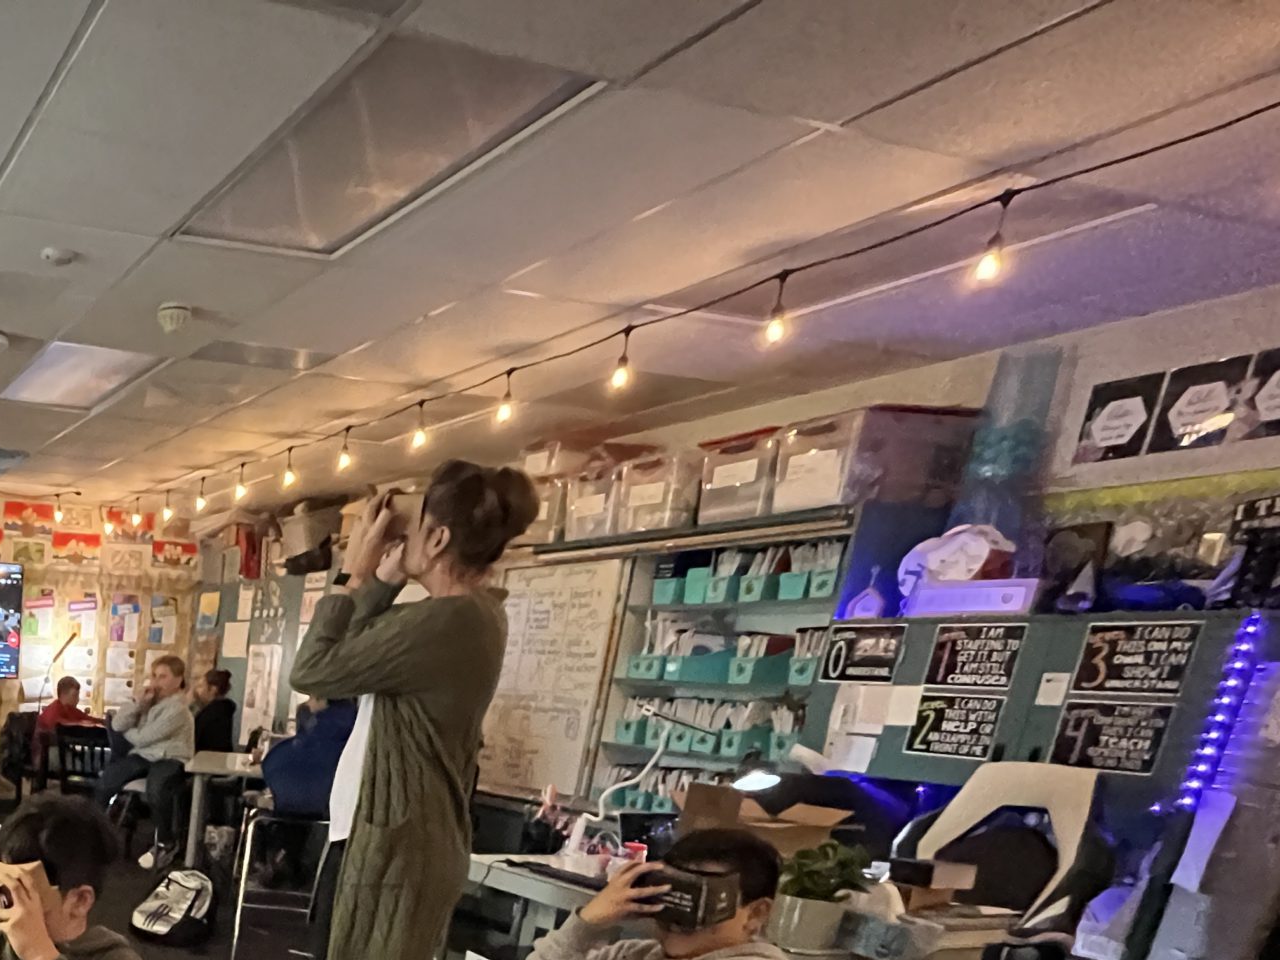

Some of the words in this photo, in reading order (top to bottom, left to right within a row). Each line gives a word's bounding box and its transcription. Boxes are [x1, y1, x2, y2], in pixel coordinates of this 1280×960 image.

[987, 628, 1004, 638] AM
[1144, 627, 1171, 639] CAN
[1172, 626, 1191, 639] DO
[1116, 640, 1145, 652] THIS
[829, 640, 846, 678] 0
[1080, 641, 1109, 688] 3
[1160, 653, 1188, 665] CAN
[1121, 666, 1160, 678] SHOW
[961, 699, 981, 709] CAN
[968, 711, 996, 722] WITH
[913, 710, 935, 749] 2
[941, 720, 977, 732] HELP
